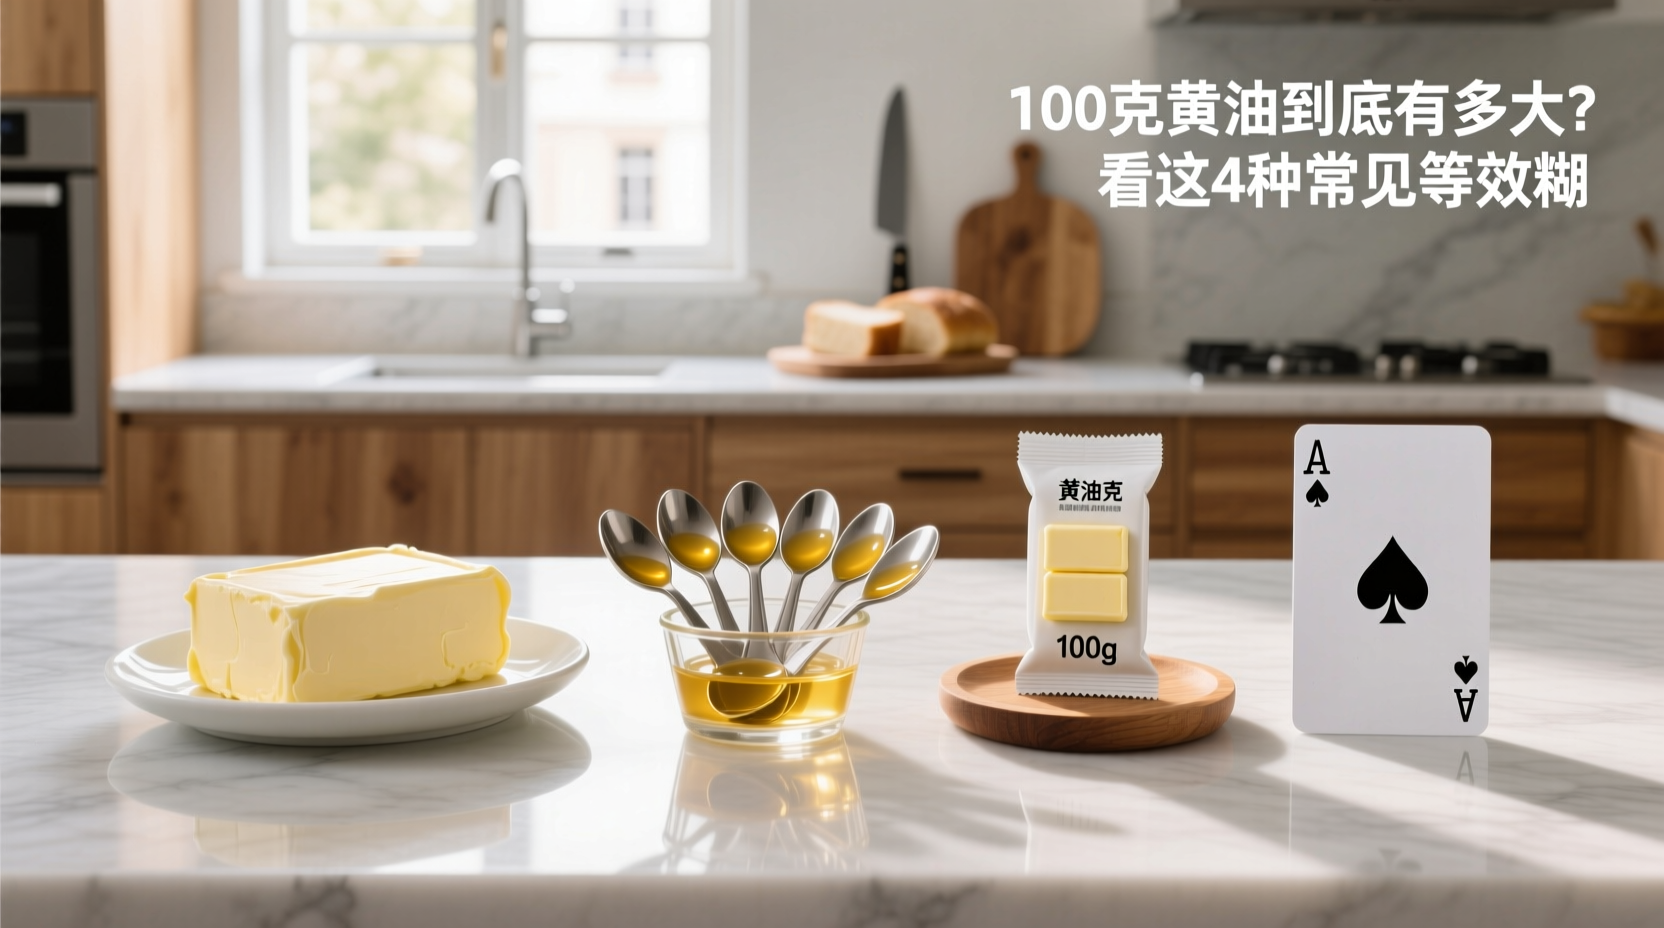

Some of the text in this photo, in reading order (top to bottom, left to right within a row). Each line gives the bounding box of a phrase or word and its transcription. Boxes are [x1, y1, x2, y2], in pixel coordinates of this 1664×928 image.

[1303, 439, 1331, 475] A
[1058, 477, 1123, 502] 黄油克
[1056, 634, 1118, 666] 100g
[1453, 688, 1479, 723] A
